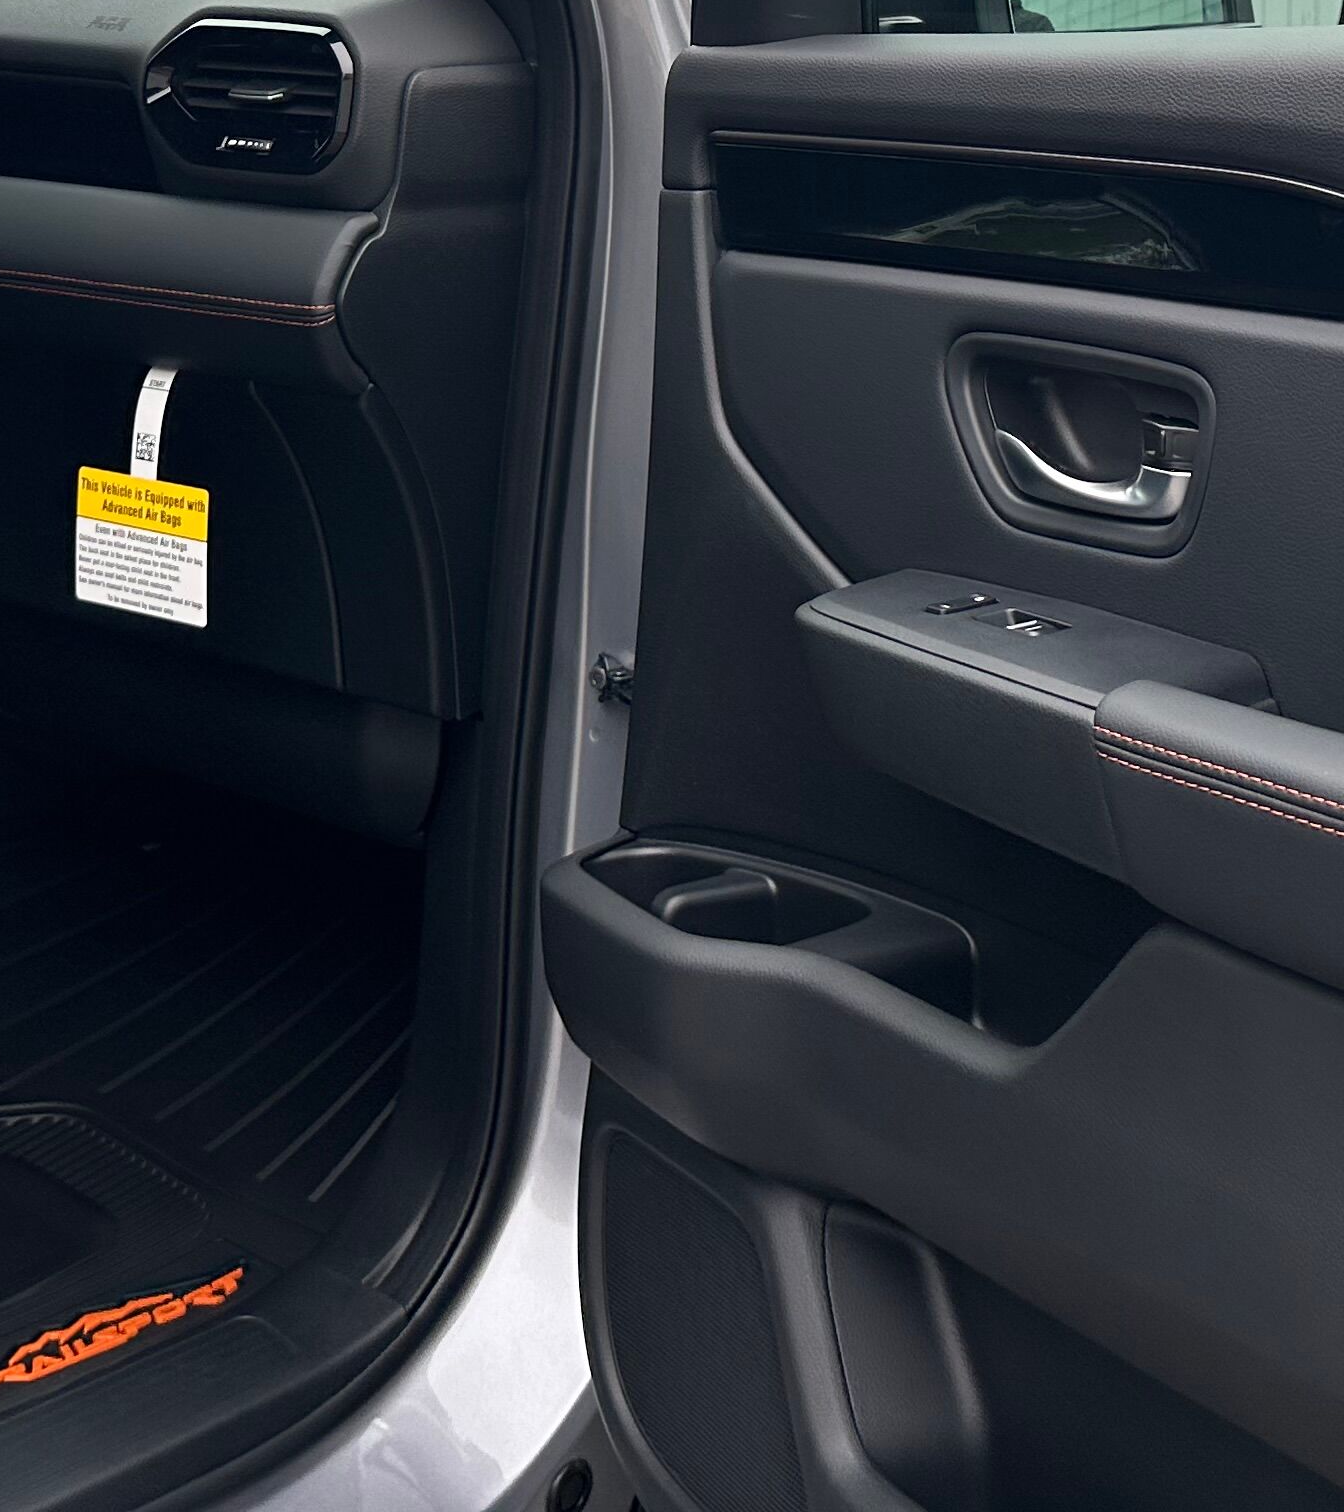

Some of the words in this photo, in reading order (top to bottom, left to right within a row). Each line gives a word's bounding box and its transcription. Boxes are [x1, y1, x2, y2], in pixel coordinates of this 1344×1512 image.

[81, 477, 99, 493] This
[102, 481, 133, 499] Vehicle
[135, 486, 143, 500] is
[145, 489, 184, 510] Equipped
[187, 497, 206, 514] with
[102, 498, 143, 519] Advanced
[146, 506, 159, 522] Air
[160, 509, 182, 528] Bags
